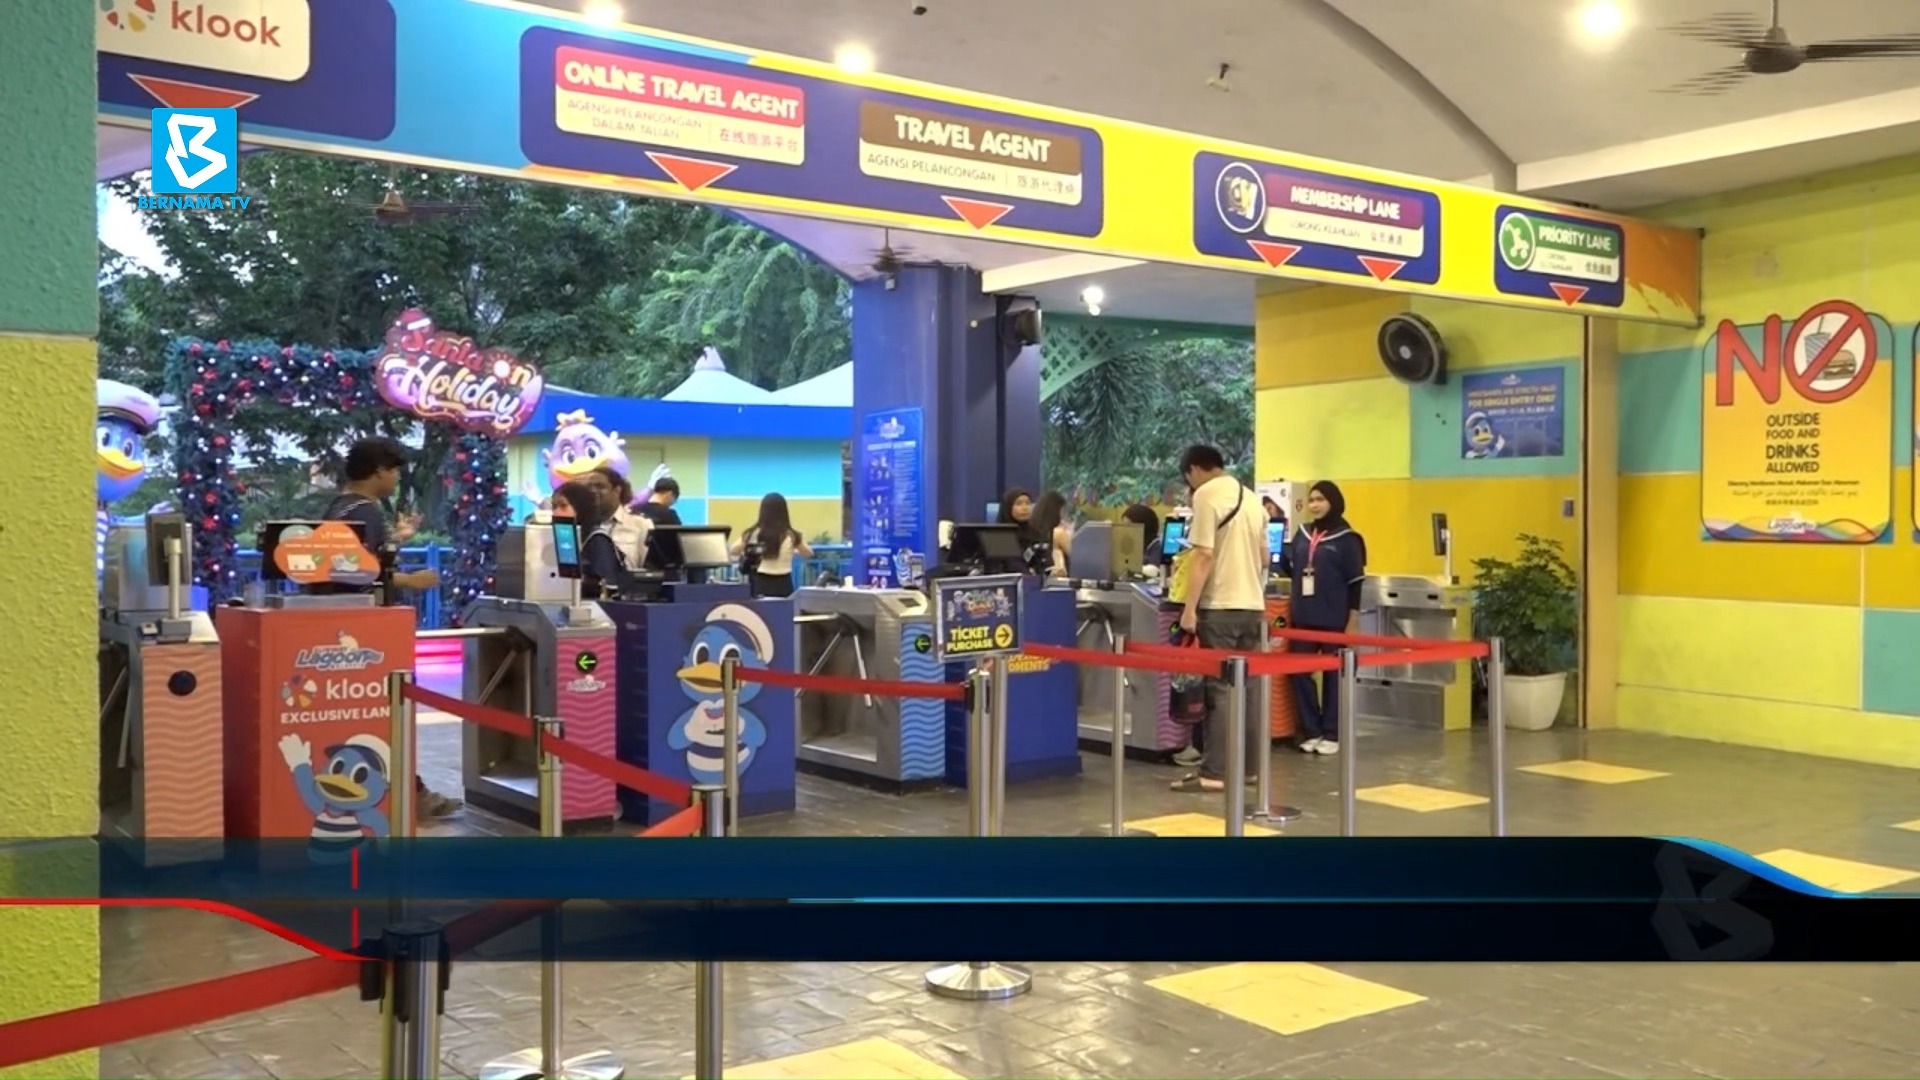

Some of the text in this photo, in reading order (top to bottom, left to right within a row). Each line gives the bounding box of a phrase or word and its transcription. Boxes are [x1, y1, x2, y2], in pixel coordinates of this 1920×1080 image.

[170, 1, 282, 48] klook
[564, 61, 799, 120] ONLINE TRAVEL AGENT
[567, 99, 702, 129] AGENSI PELANCONGAN
[592, 117, 681, 139] DALAM TALIAN
[894, 114, 1052, 163] TRAVEL AGENT
[867, 153, 996, 182] AGENSI PELANCONGAN
[1291, 186, 1401, 220] MEMBERSHIP LANE
[1539, 225, 1612, 252] PRIORITY LANE
[398, 355, 521, 431] Holiday
[1767, 412, 1820, 427] OUTSIDE
[1766, 428, 1820, 440] FOOD AND
[1766, 443, 1820, 459] DRINKS
[1766, 461, 1820, 474] ALLOWED
[946, 638, 994, 652] PURCHASE
[950, 626, 990, 641] TICKET
[280, 705, 391, 724] EXCLUSIVE LAN
